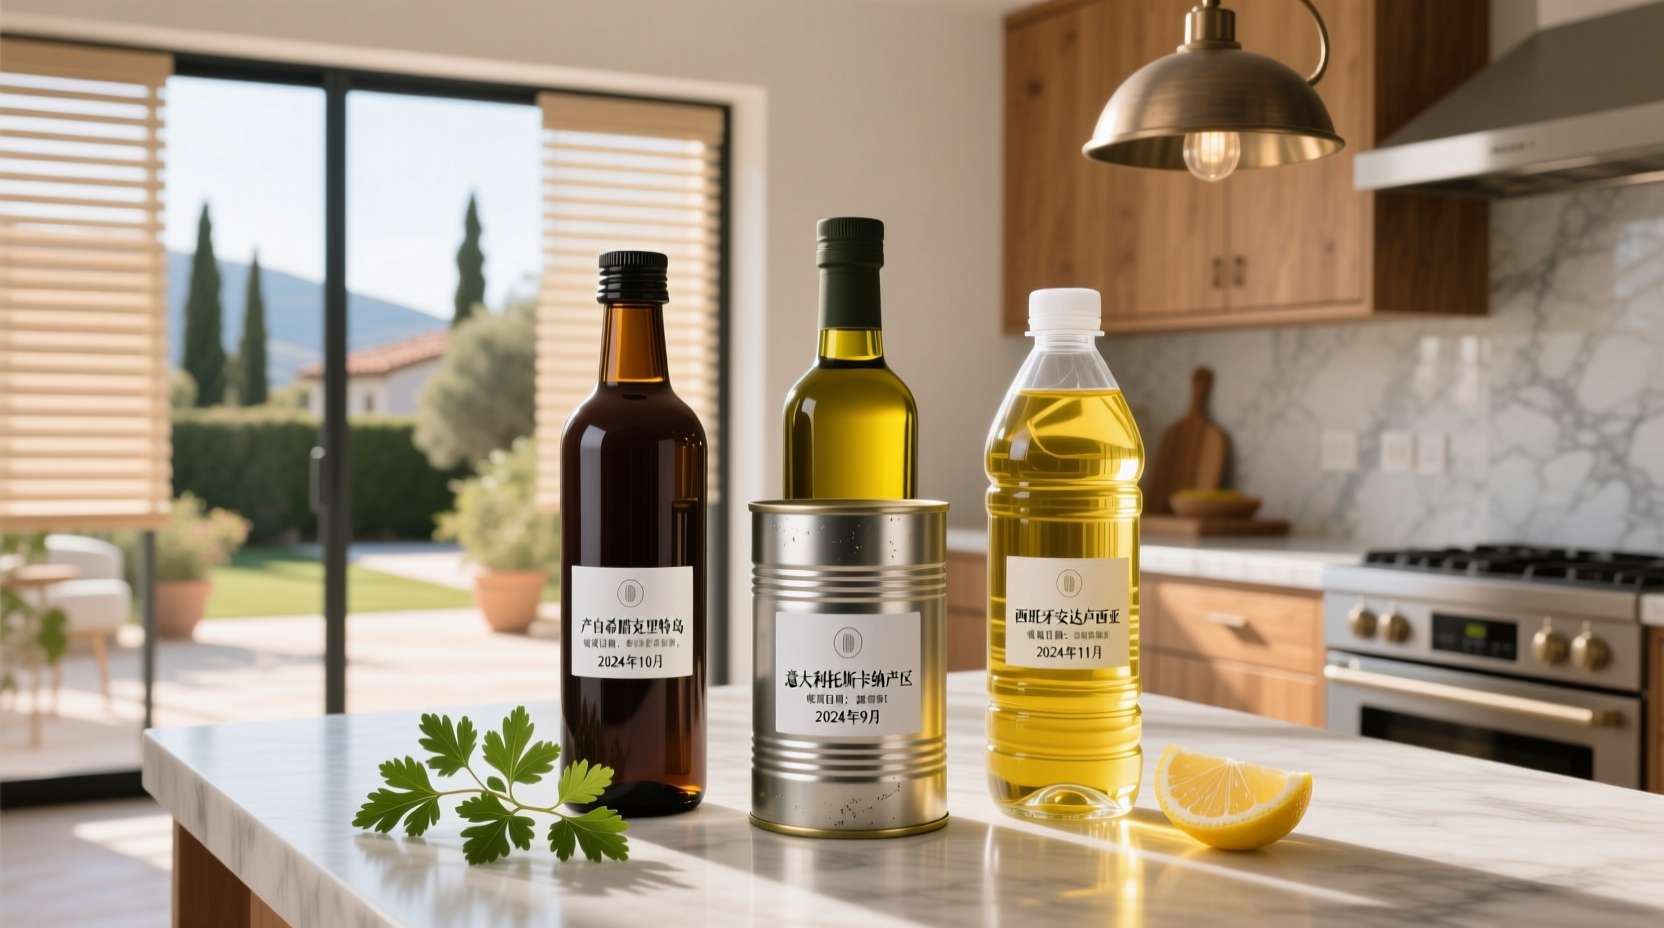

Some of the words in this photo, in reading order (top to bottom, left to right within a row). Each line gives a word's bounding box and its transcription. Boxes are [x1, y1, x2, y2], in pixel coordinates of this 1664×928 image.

[1036, 645, 1102, 660] 2024年11月
[597, 654, 662, 670] 2024年10月
[815, 709, 880, 726] 2024年9月
